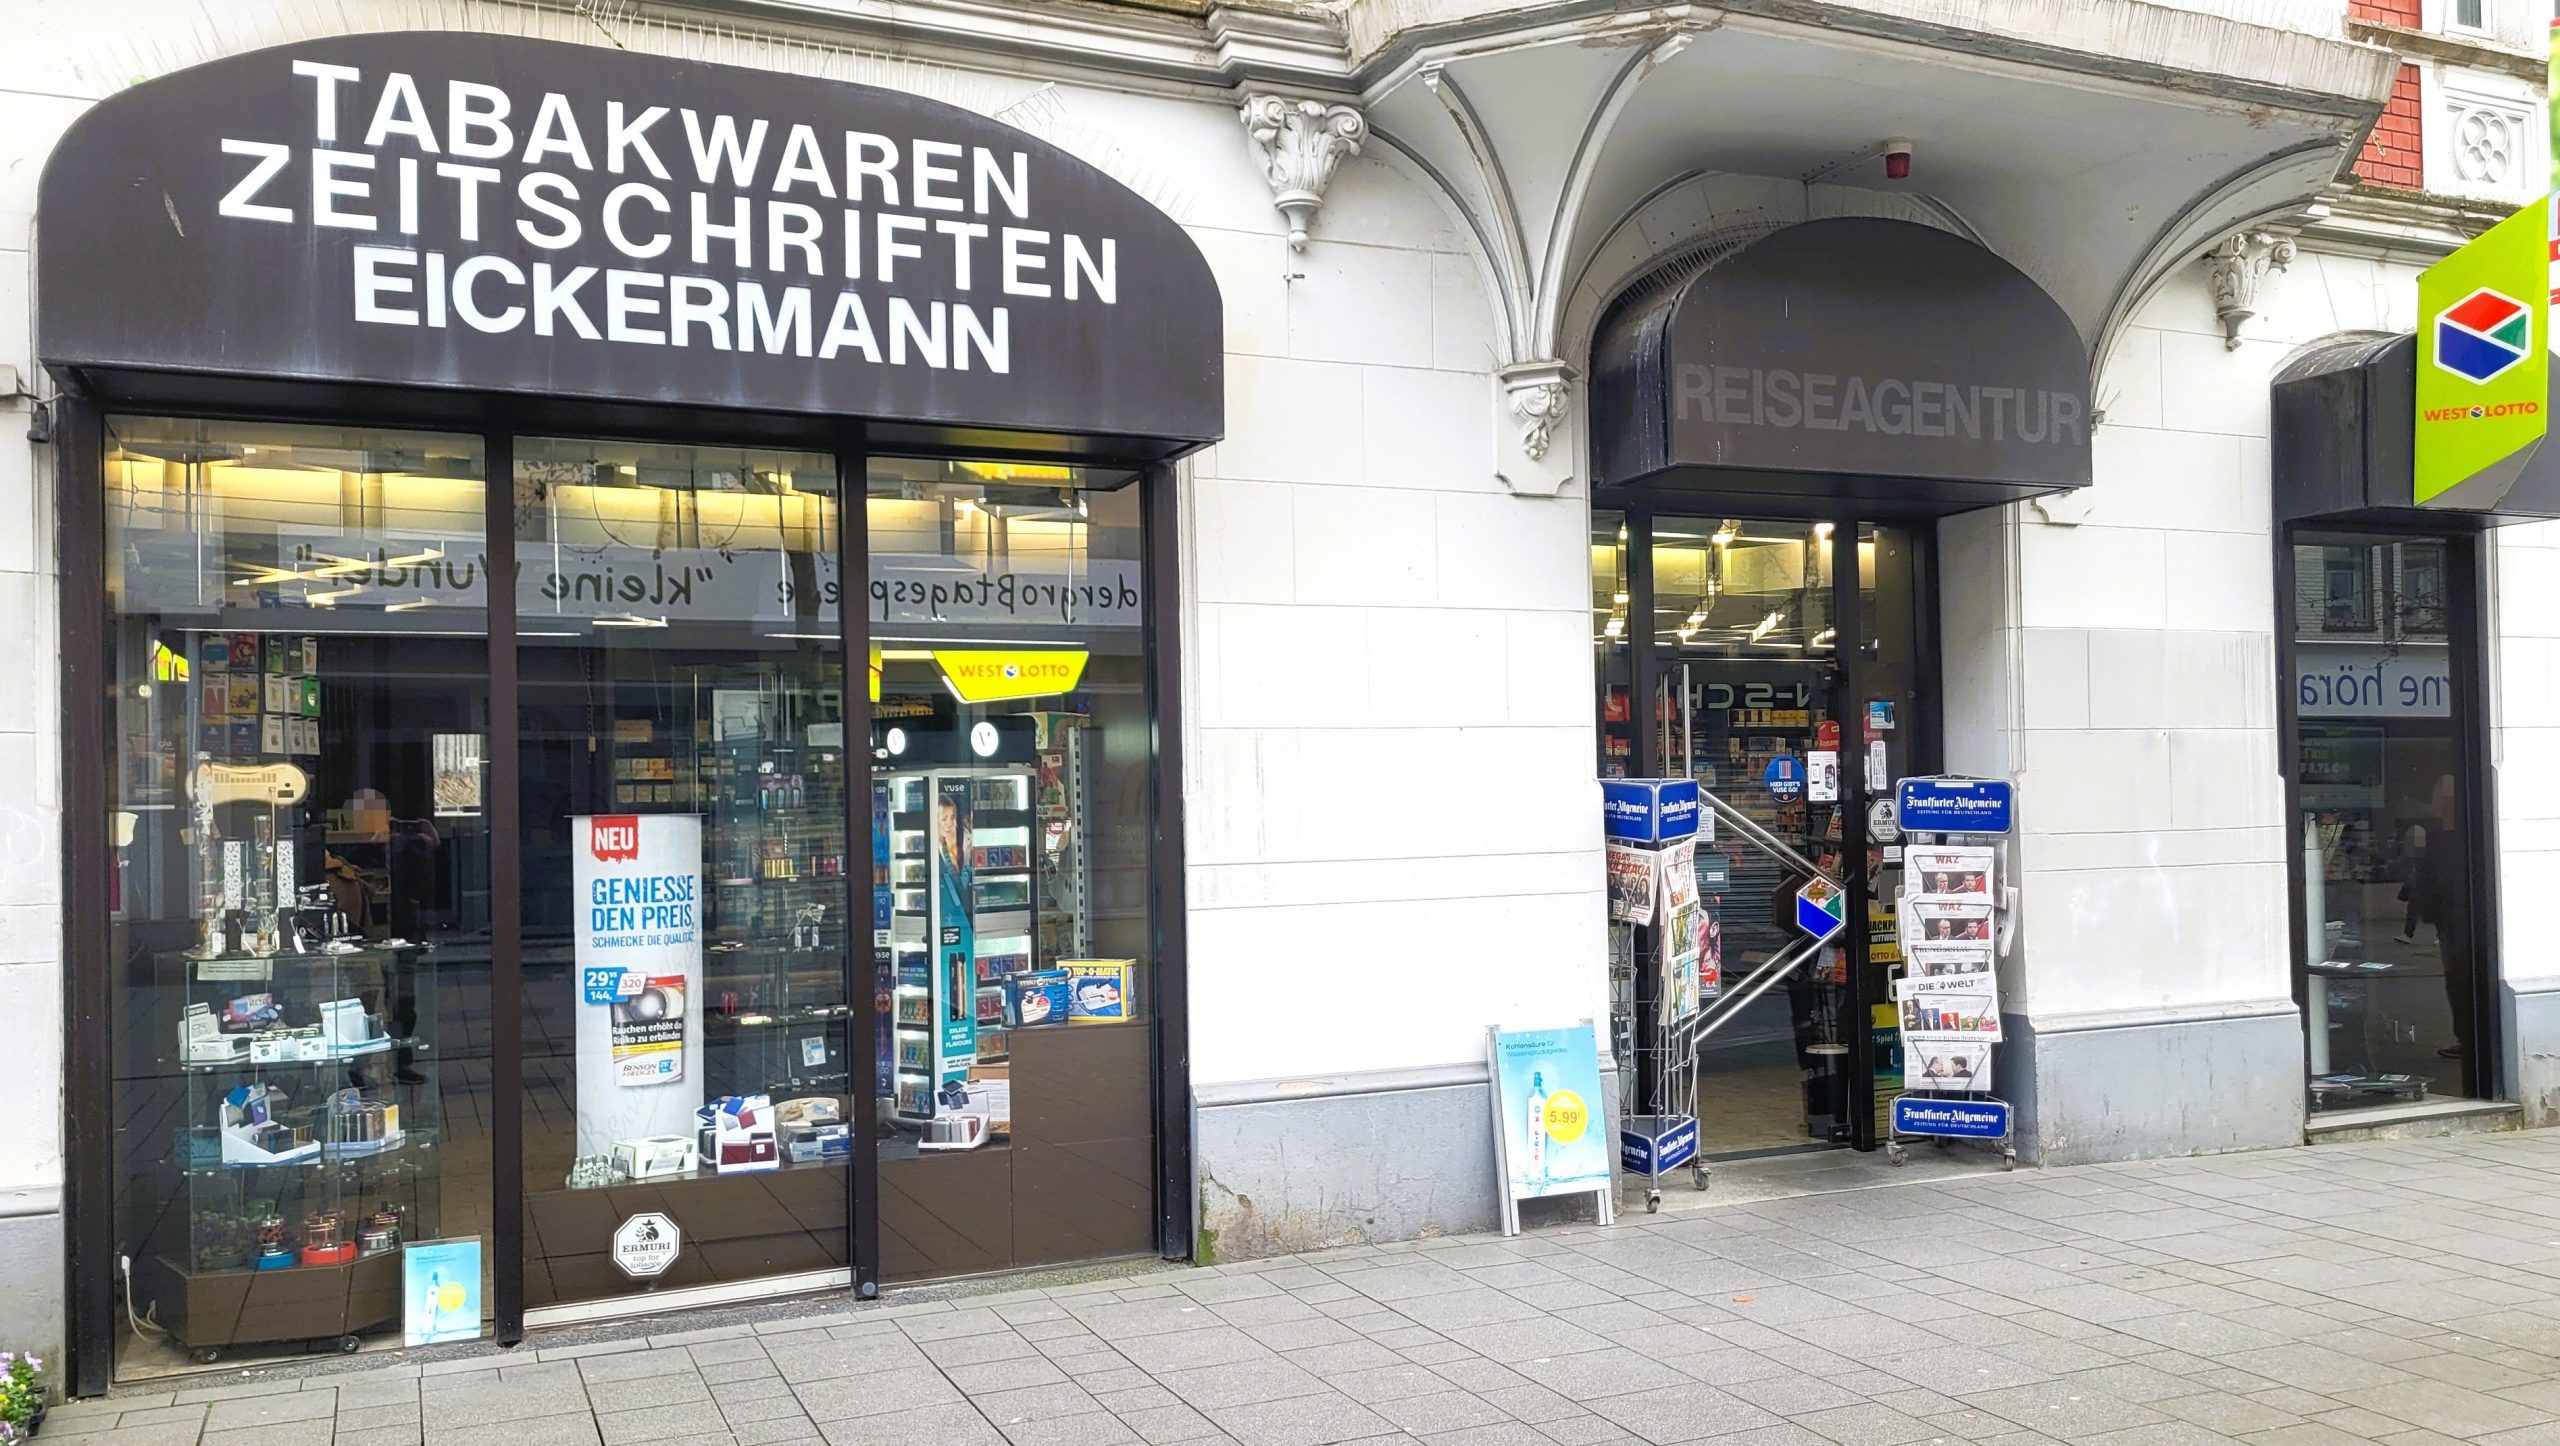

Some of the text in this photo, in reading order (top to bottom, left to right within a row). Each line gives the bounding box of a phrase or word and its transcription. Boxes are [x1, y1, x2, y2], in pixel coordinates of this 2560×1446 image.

[293, 60, 1028, 218] TABAKWAREN
[219, 138, 1117, 304] ZEITSCHRIFTEN
[353, 245, 1009, 374] EICKERMANN
[1676, 364, 2082, 446] REISEAGENTUR
[2424, 401, 2539, 422] WEST LOTTO
[959, 664, 1070, 677] WEST LOTTO
[1617, 800, 1648, 814] Allgemeine
[1906, 796, 2002, 809] Frankfurter Allgemeine
[594, 826, 634, 851] NEU
[1935, 855, 1960, 864] WAZ
[592, 875, 695, 905] GENIESSE
[1938, 903, 1963, 912] WAZ
[592, 903, 695, 932] DEN PREIS,
[592, 935, 644, 948] SCHMECKE
[647, 934, 661, 946] DIE
[1918, 983, 1935, 991] DIE
[612, 1024, 646, 1035] Rauchen
[648, 1022, 673, 1031] erhöht
[1506, 1042, 1546, 1050] Kohlensäure
[1904, 1107, 1998, 1124] Frankfurter Allgemeine
[622, 1243, 671, 1252] ERMURI
[630, 1261, 662, 1269] tobacco
